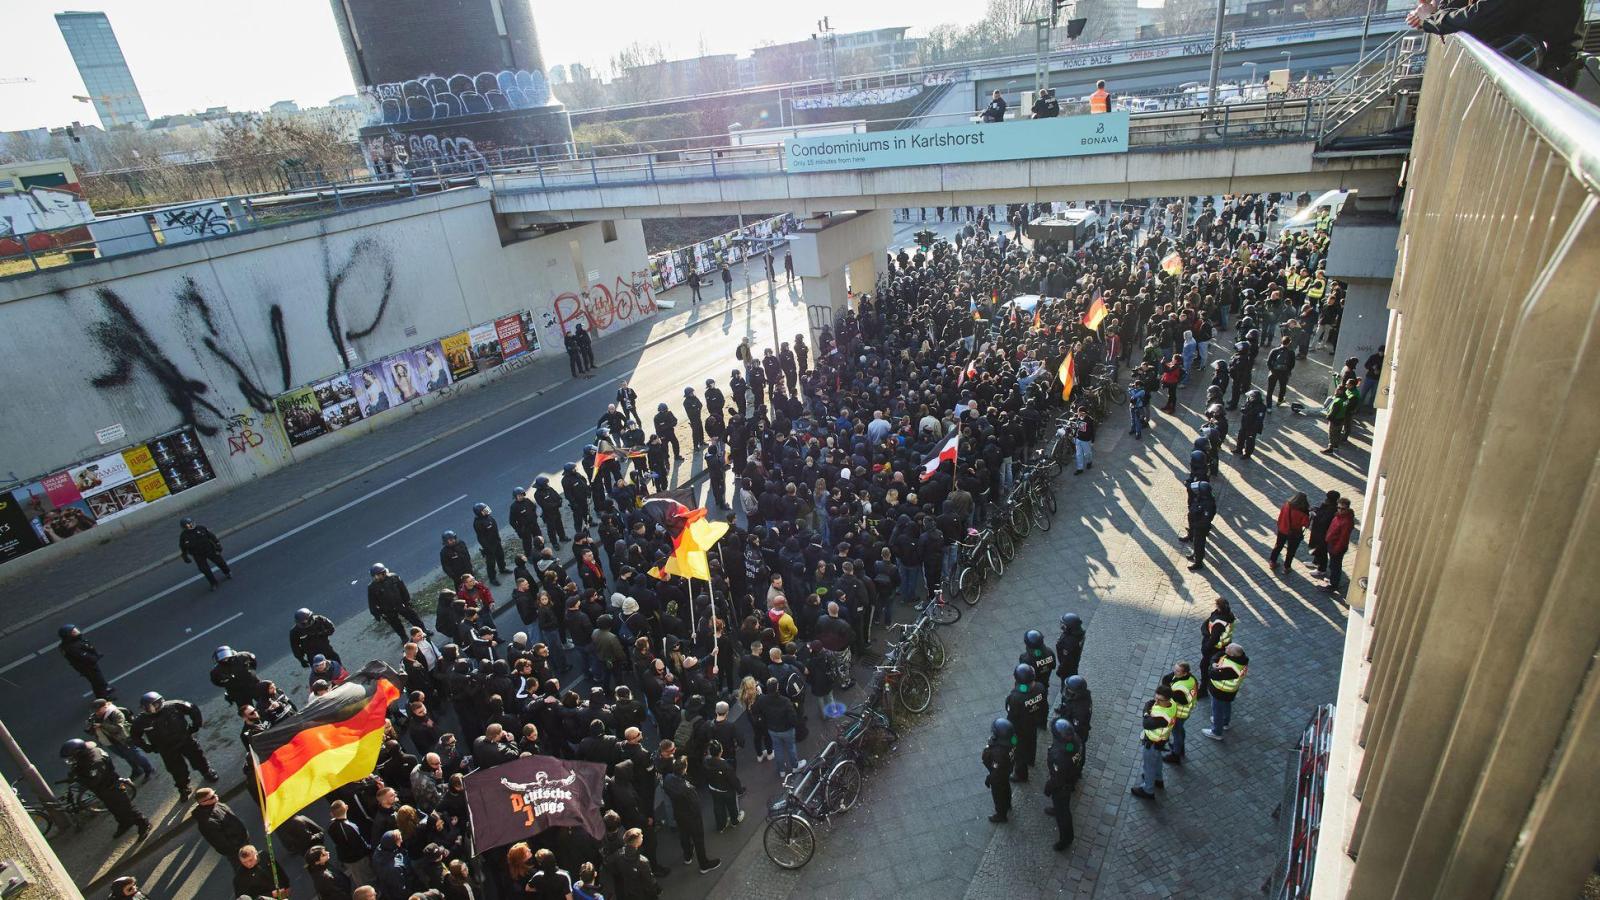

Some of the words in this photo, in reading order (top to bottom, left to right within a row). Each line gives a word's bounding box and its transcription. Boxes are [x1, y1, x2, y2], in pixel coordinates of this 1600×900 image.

[792, 140, 890, 157] Condominiums
[894, 135, 906, 149] in
[911, 131, 985, 148] Karlshorst
[1081, 136, 1119, 145] BONAVA
[510, 787, 572, 813] Deutsche
[522, 800, 565, 827] Jungs
